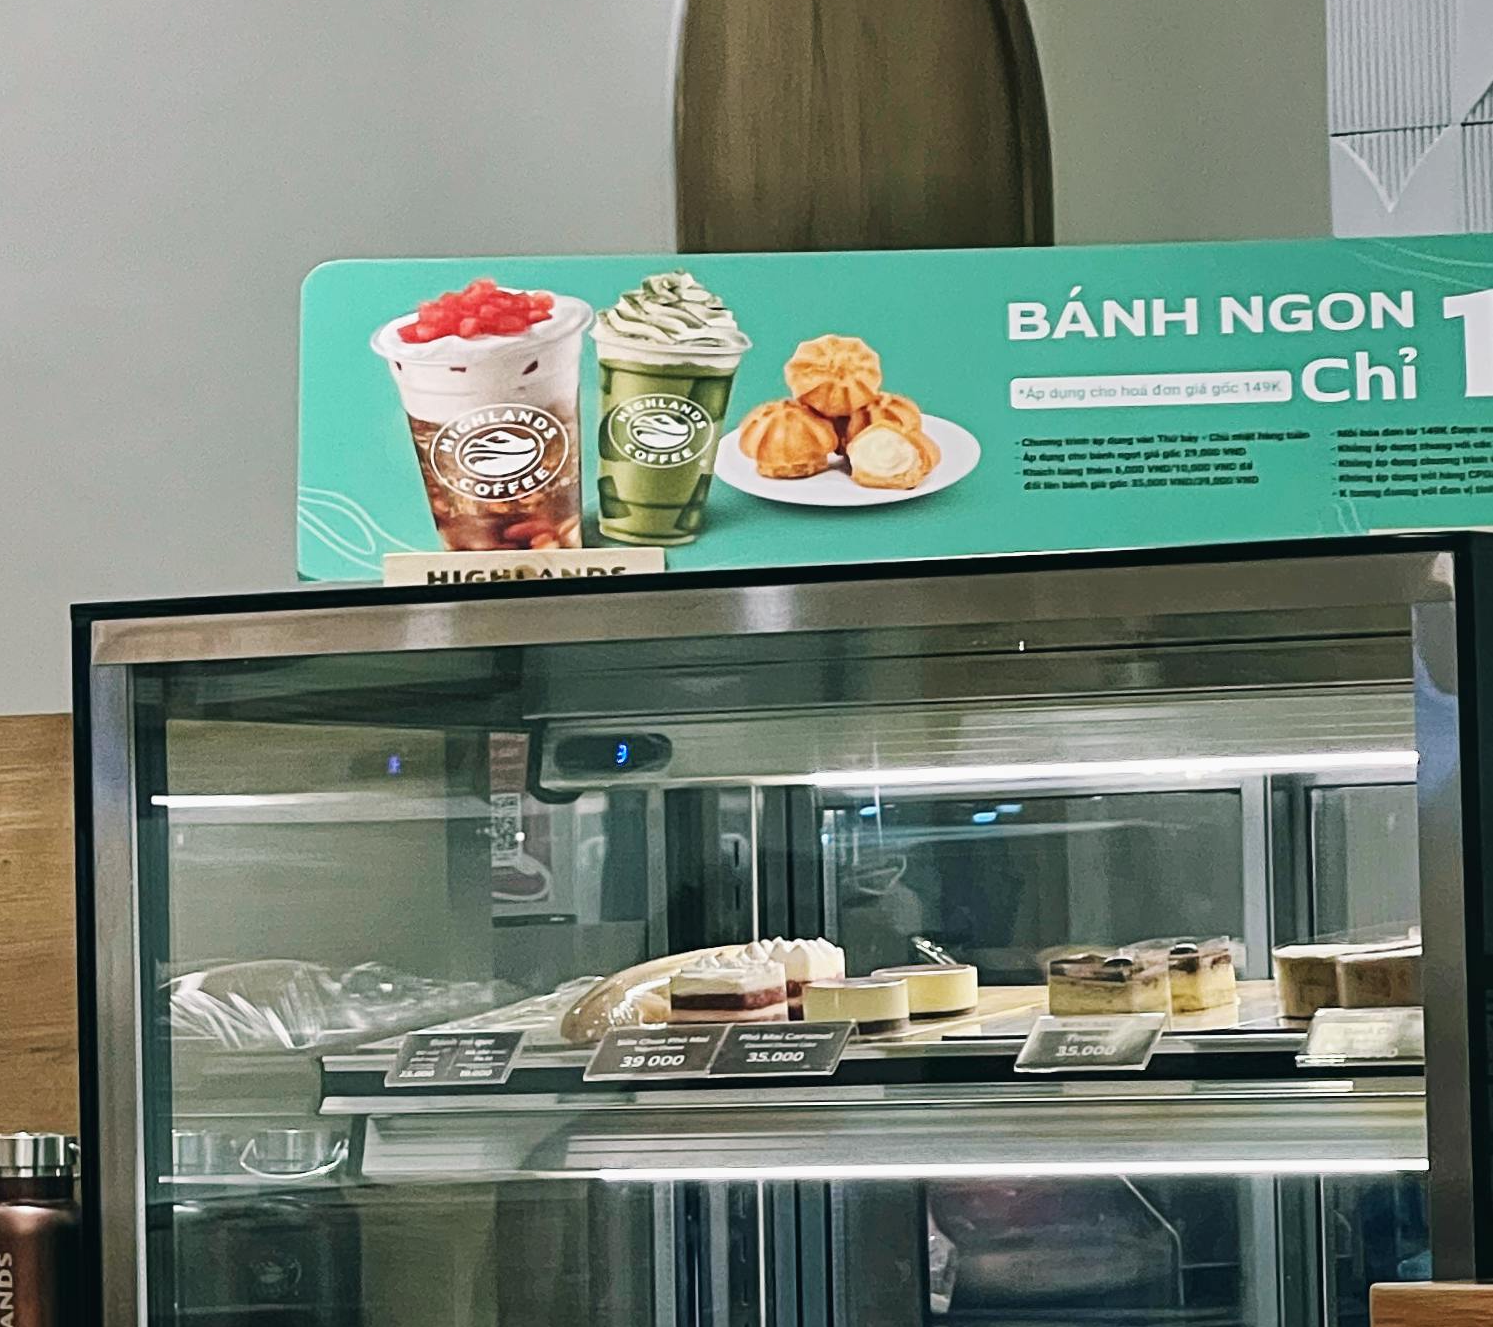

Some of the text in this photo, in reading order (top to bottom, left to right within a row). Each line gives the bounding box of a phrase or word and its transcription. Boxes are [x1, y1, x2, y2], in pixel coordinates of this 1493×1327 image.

[1007, 285, 1199, 340] BÁNH
[1219, 290, 1414, 334] NGON
[1090, 386, 1116, 397] cho
[1243, 381, 1282, 393] 149K
[1301, 346, 1418, 403] Chỉ
[616, 396, 708, 430] HIGHLANDS
[438, 409, 558, 453] HIGHLANDS
[623, 443, 694, 465] COFFEE
[459, 466, 551, 497] COFFEE
[746, 1051, 804, 1063] 35.000
